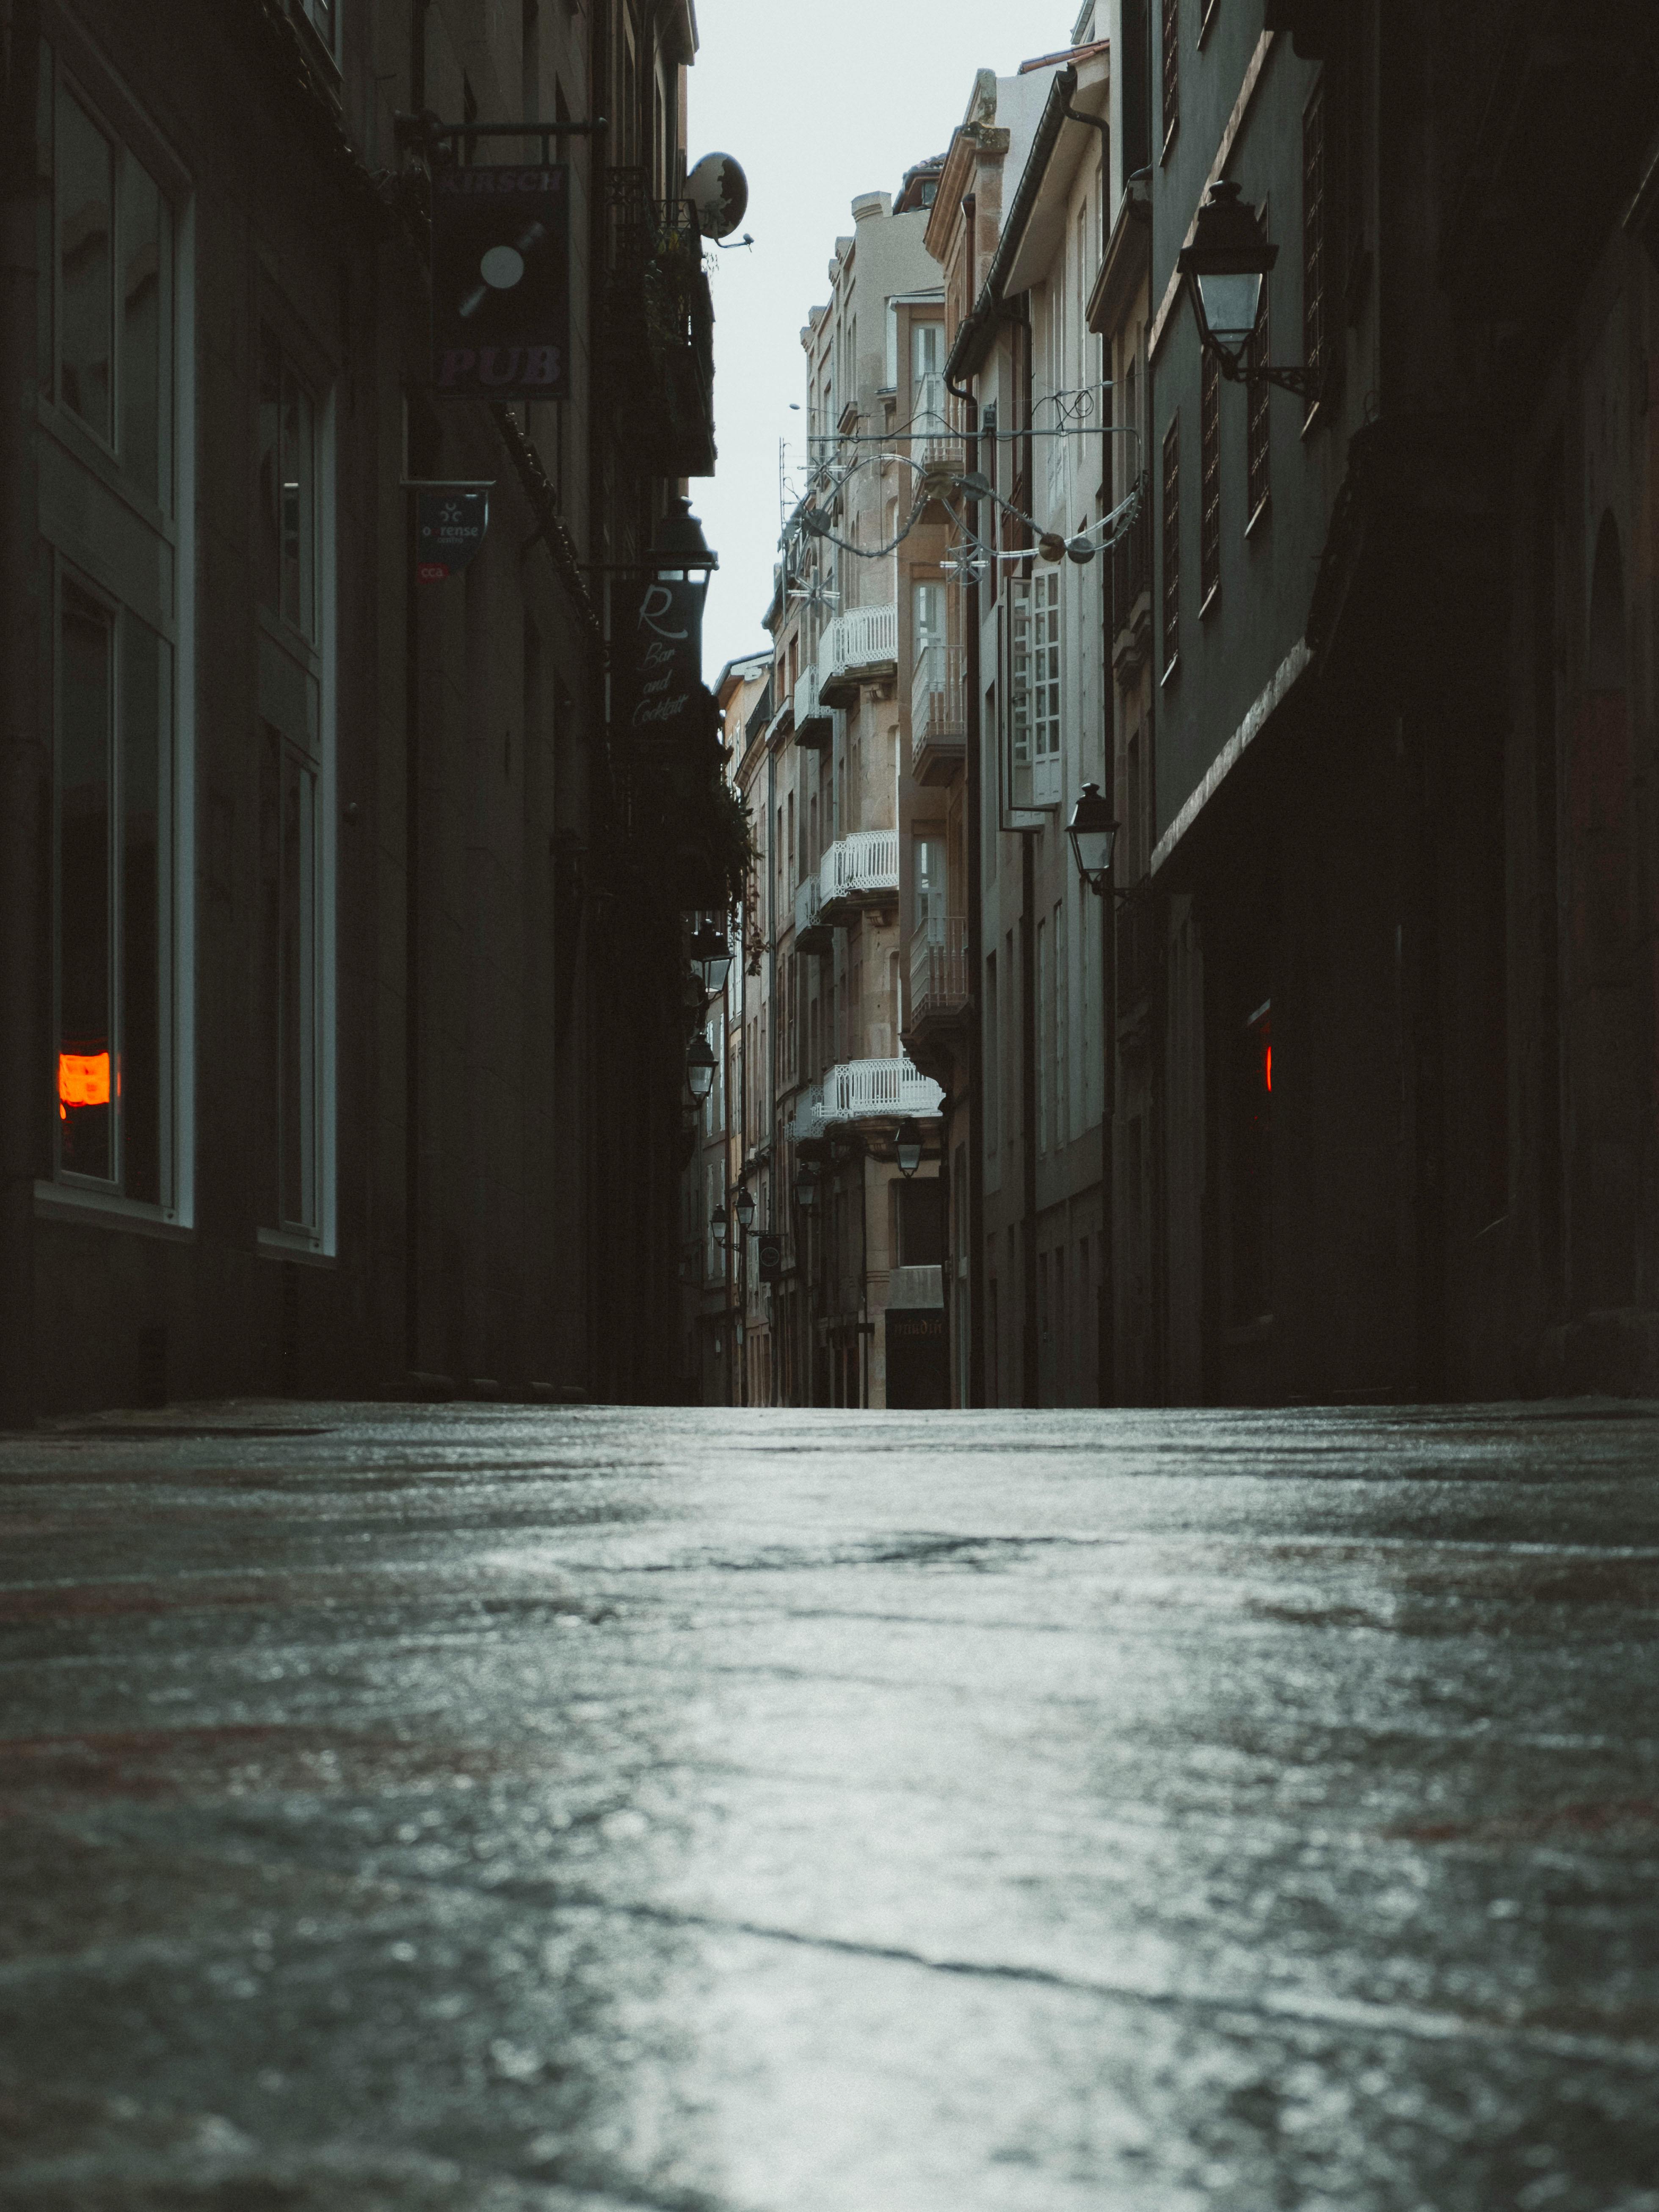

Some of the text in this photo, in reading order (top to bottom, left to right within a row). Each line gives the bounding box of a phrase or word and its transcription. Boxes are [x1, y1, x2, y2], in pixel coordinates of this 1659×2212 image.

[437, 345, 561, 387] PUB
[637, 584, 688, 638] R
[636, 642, 676, 671] Bar
[643, 669, 673, 694] and
